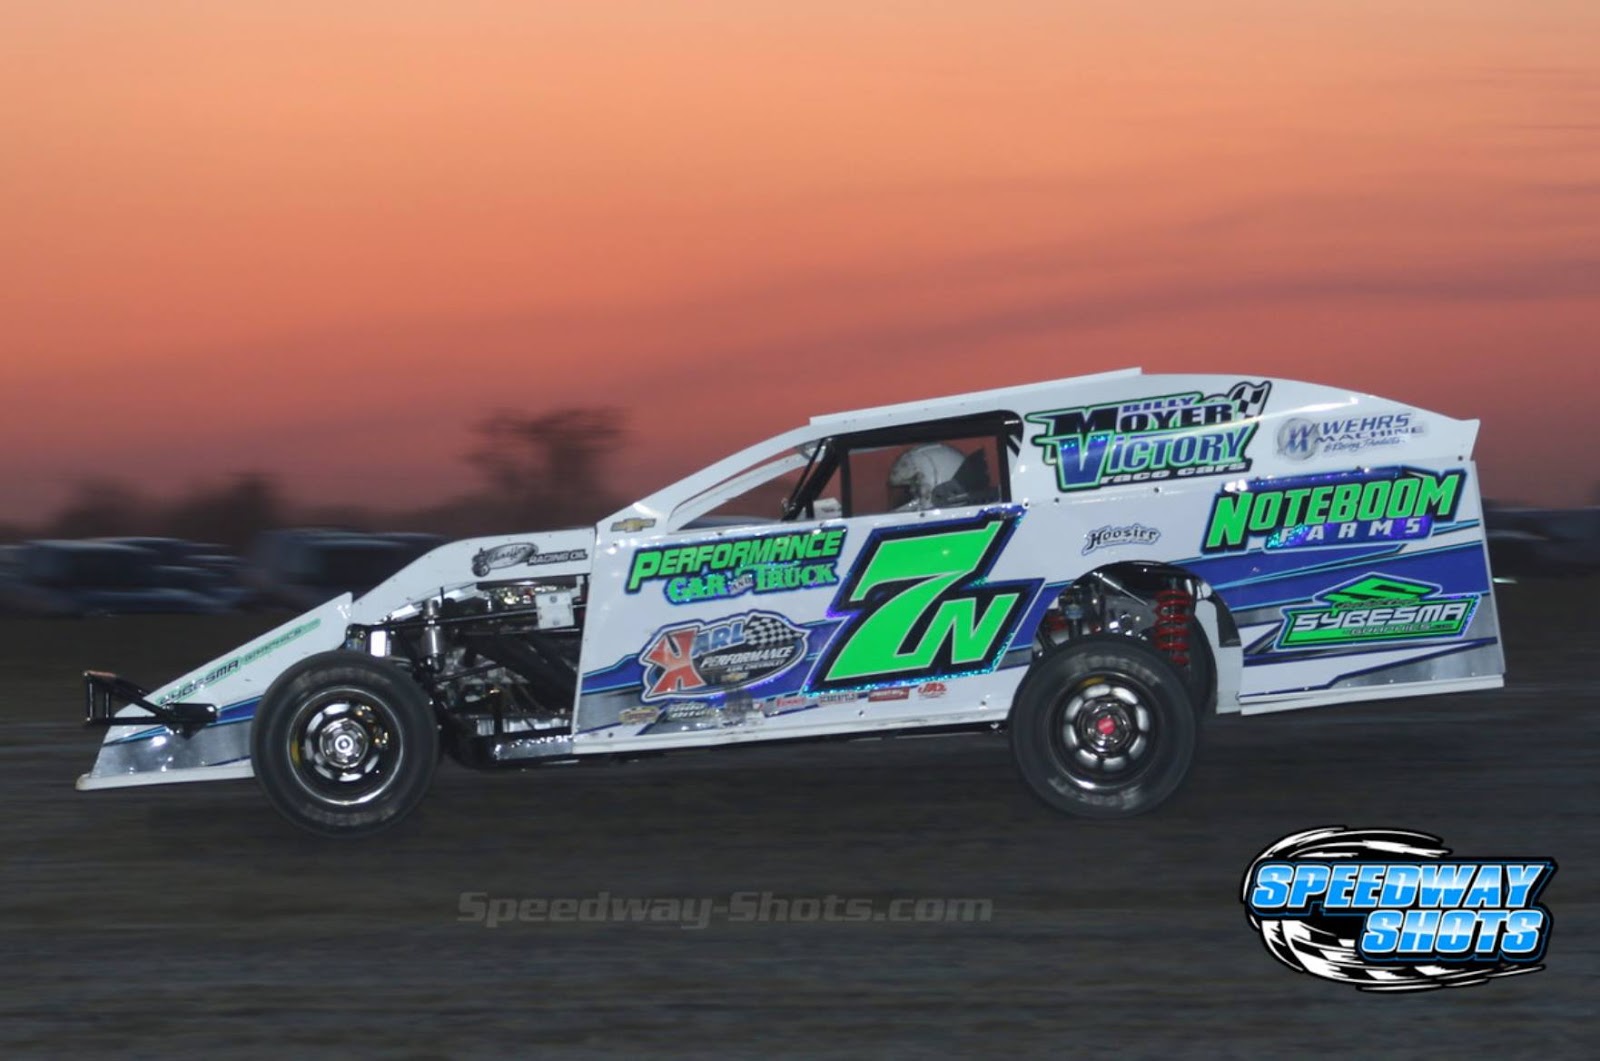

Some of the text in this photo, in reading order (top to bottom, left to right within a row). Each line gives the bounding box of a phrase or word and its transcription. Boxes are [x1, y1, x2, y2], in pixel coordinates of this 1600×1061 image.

[1121, 396, 1198, 413] BILLY
[1037, 403, 1233, 436] MOYER
[1322, 413, 1412, 435] WEHRS
[1314, 425, 1425, 443] MACHINE
[1100, 461, 1247, 484] race cars
[1206, 475, 1460, 548] NOTEBOOM
[1085, 525, 1157, 551] Hoosier
[1279, 517, 1421, 543] FARMS
[627, 530, 845, 591] PERFORMANCE
[668, 574, 727, 601] CAR
[736, 562, 838, 592] TRUCK
[1292, 602, 1469, 632] SYBESMA
[701, 646, 795, 668] PERFORMANCE
